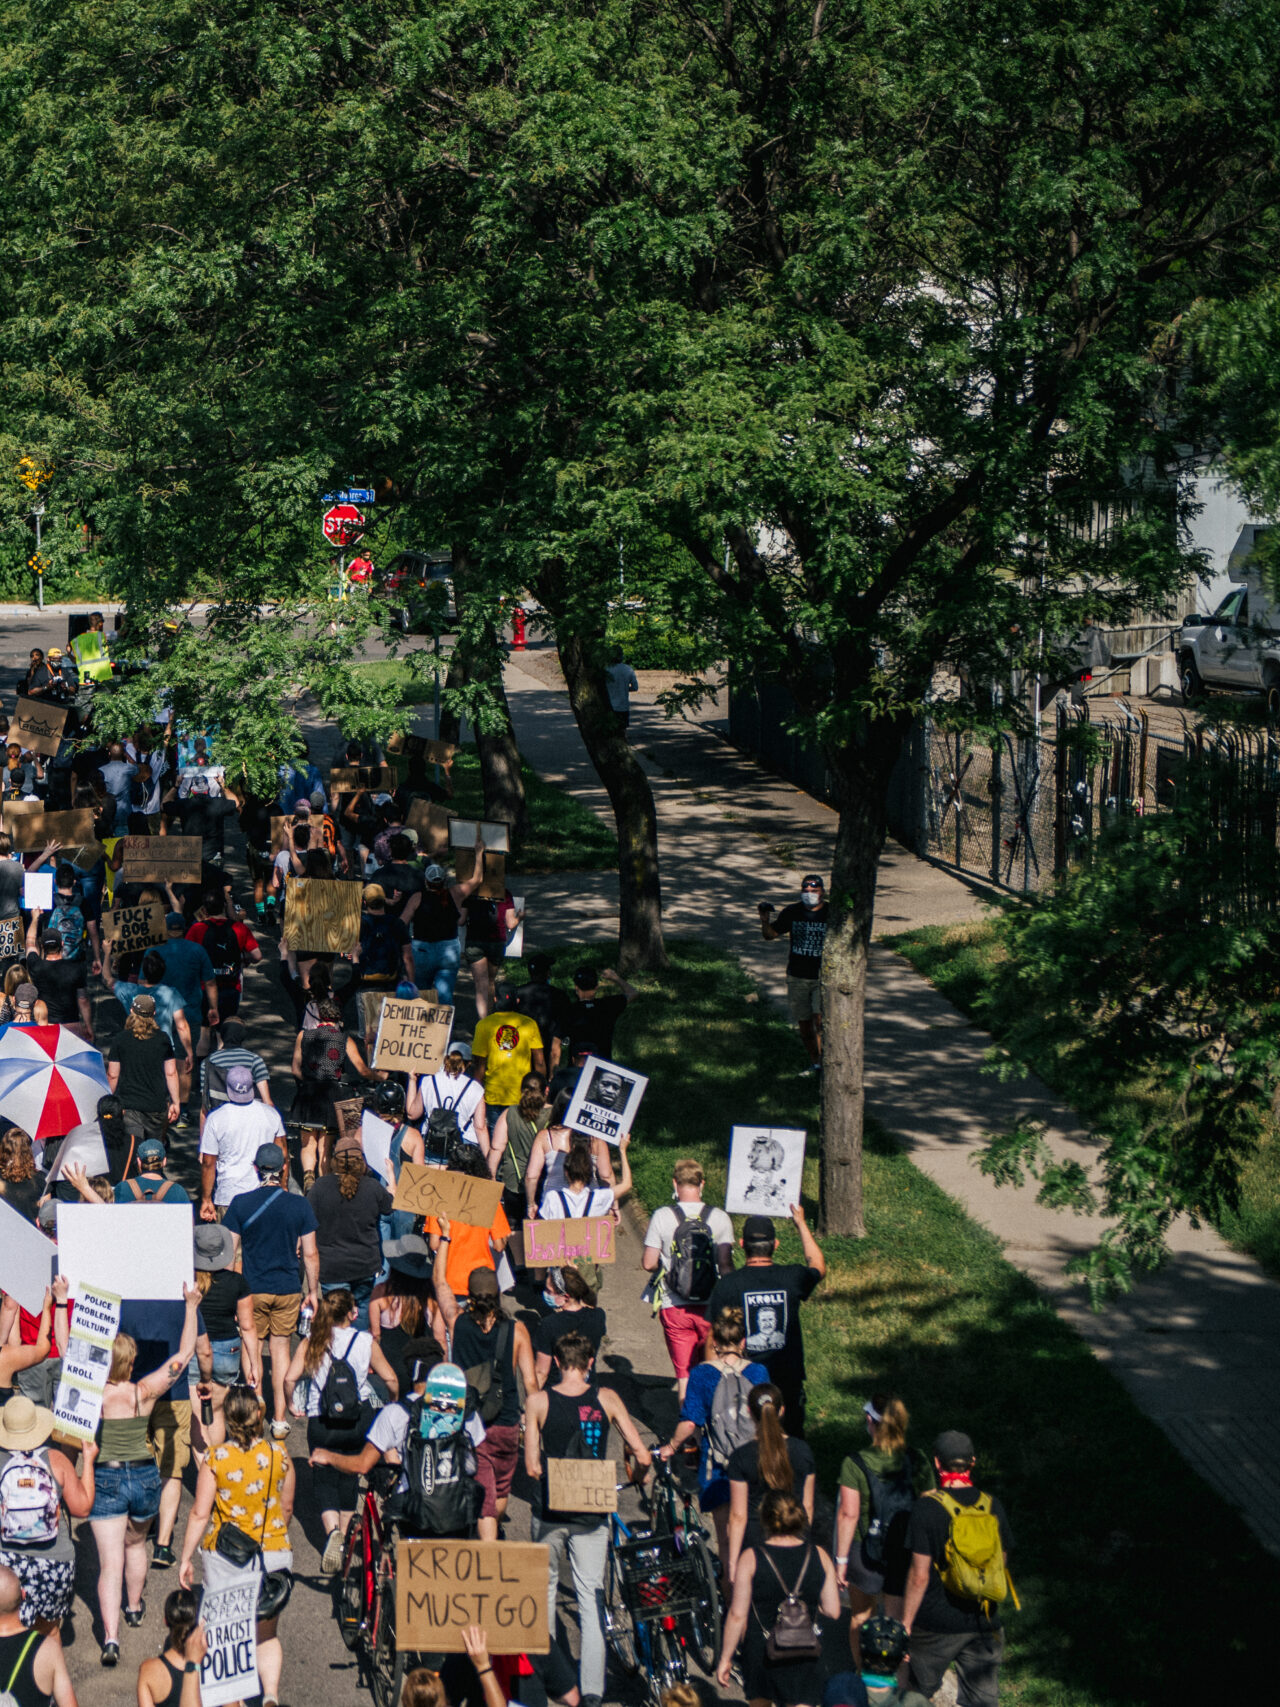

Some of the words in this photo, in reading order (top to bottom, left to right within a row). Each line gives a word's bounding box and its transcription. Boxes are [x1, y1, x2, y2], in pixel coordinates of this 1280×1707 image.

[113, 908, 153, 926] FUCK
[121, 922, 150, 939] BOB
[383, 1003, 453, 1026] DEMILITARIZE
[400, 1024, 427, 1039] THE
[380, 1039, 437, 1061] POLICE.
[584, 1103, 618, 1120] JUSTICE
[579, 1116, 616, 1137] FLOYD
[84, 1294, 112, 1310] POLICE
[748, 1294, 784, 1304] KROLL
[74, 1303, 119, 1325] PROBLEMS:
[76, 1317, 110, 1336] KULTURE
[67, 1364, 94, 1381] KROLL
[55, 1408, 93, 1429] KOUNSEL
[582, 1486, 615, 1506] ICE
[407, 1546, 520, 1583] KROLL
[407, 1591, 490, 1628] MUST
[496, 1594, 537, 1628] GO
[216, 1618, 252, 1646] RACIST
[201, 1639, 255, 1685] POLICE
